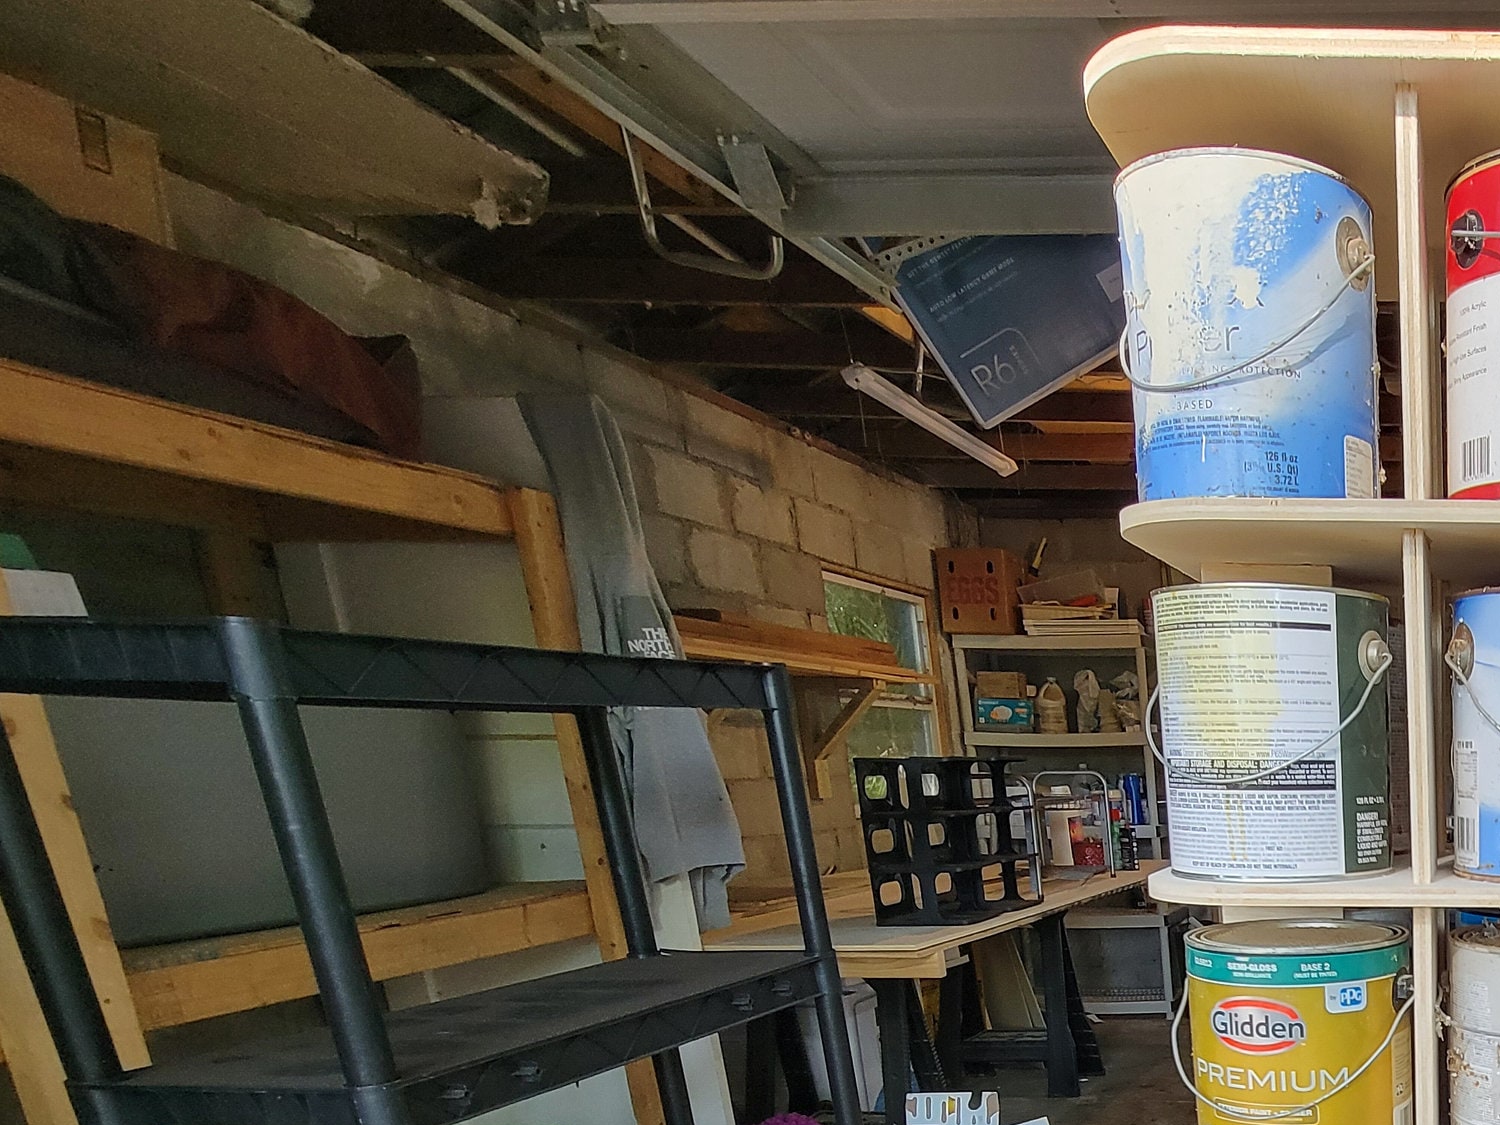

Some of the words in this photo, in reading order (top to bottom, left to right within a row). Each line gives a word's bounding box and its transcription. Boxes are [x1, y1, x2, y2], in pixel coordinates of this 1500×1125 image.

[1236, 365, 1301, 379] ROTECTION
[1265, 452, 1278, 461] 126
[1289, 454, 1298, 463] oz
[1275, 475, 1293, 485] 3.72
[627, 639, 674, 653] NORTH
[1227, 962, 1277, 972] SEMI-GLOSS
[1301, 963, 1322, 971] BASE
[1341, 987, 1363, 1007] PPG
[1213, 1011, 1304, 1038] Glidden
[1197, 1058, 1350, 1092] PREMIUM
